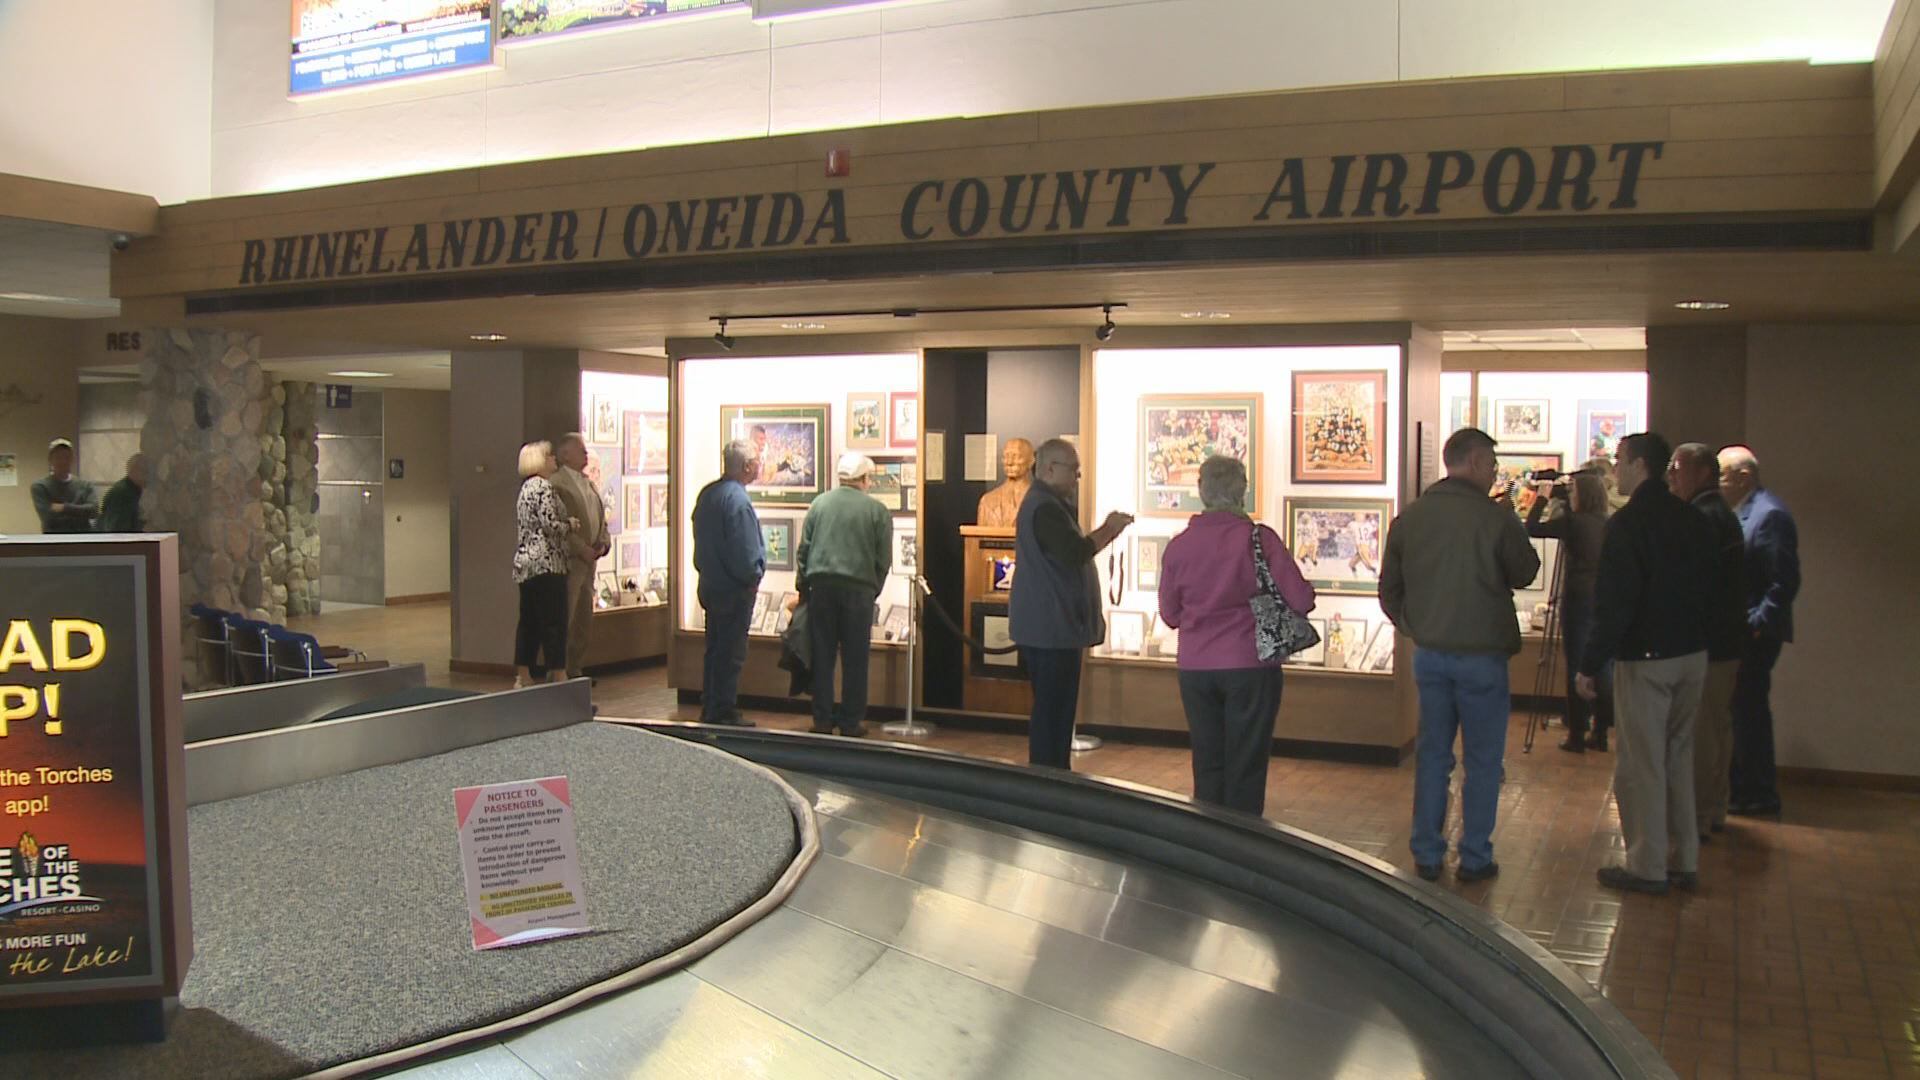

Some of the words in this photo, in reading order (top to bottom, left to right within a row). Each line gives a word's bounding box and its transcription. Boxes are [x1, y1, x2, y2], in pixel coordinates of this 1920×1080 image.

[239, 208, 579, 285] RHINELANDER
[623, 188, 850, 259] ONEIDA
[901, 162, 1216, 240] COUNTY
[1253, 141, 1664, 220] AIRPORT
[0, 618, 107, 671] AD
[0, 684, 63, 736] P!
[0, 769, 31, 786] the
[35, 766, 113, 785] Torches
[488, 790, 522, 802] NOTICE
[525, 788, 537, 798] TO
[5, 795, 49, 817] app!
[484, 799, 544, 814] PASSENGERS
[503, 813, 525, 822] accept
[527, 810, 546, 818] items
[473, 824, 505, 834] unknown
[506, 822, 533, 830] persons
[543, 817, 560, 825] carry
[492, 832, 503, 840] the
[43, 846, 69, 860] OF
[482, 844, 509, 854] Control
[510, 842, 525, 852] your
[526, 838, 556, 848] carry-on
[506, 852, 525, 860] order
[44, 861, 80, 875] THE
[478, 861, 520, 872] introduction
[501, 868, 527, 878] without
[529, 866, 544, 874] your
[62, 904, 100, 914] CASINO
[5, 936, 53, 949] MORE
[55, 933, 87, 946] FUN
[9, 952, 53, 976] the
[62, 936, 134, 974] Lake!
